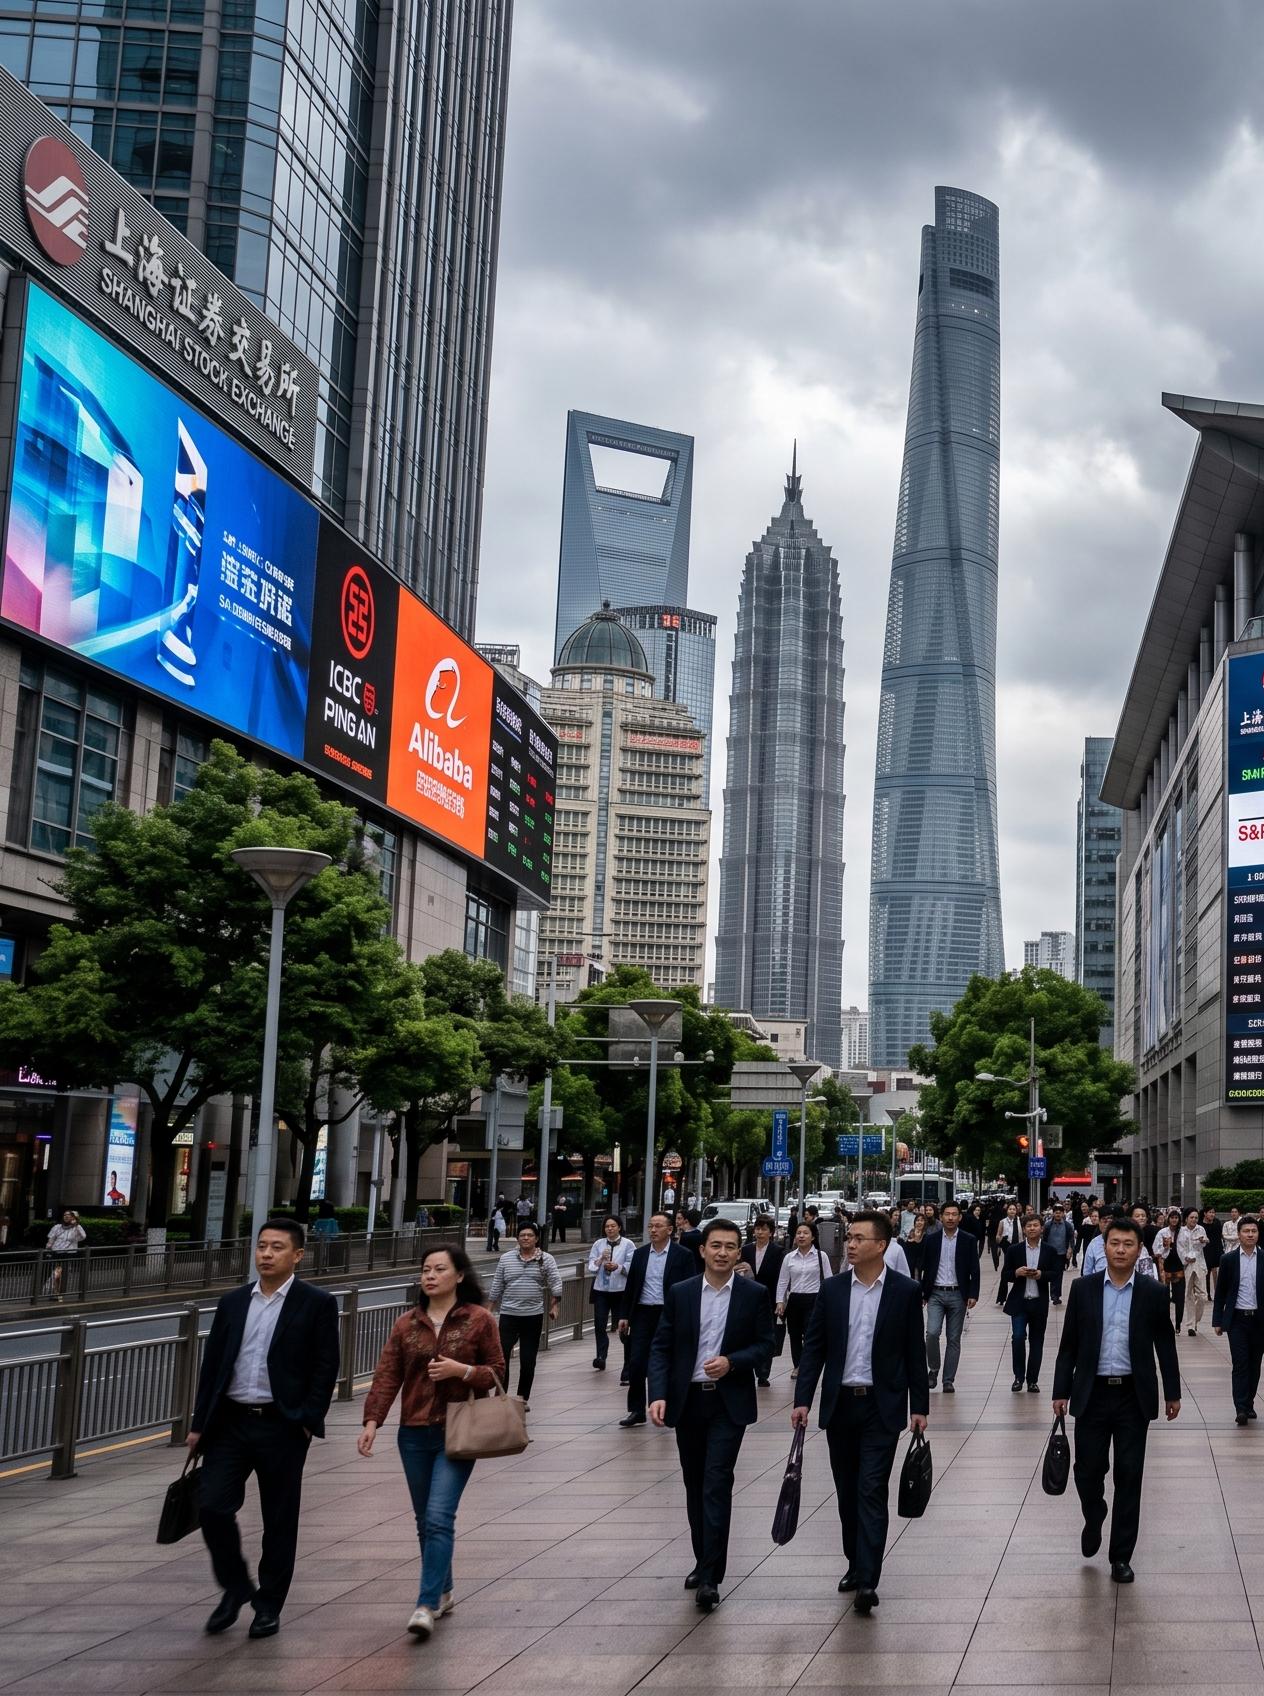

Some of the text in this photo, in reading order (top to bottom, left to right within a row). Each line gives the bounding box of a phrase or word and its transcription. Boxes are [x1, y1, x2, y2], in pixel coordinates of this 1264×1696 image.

[104, 206, 300, 418] 上海证券交易所
[101, 267, 296, 450] SHANGHAI STOCK EXCHANGE
[329, 659, 362, 705] ICBC
[324, 696, 377, 750] PING AN
[408, 722, 473, 791] Alibaba
